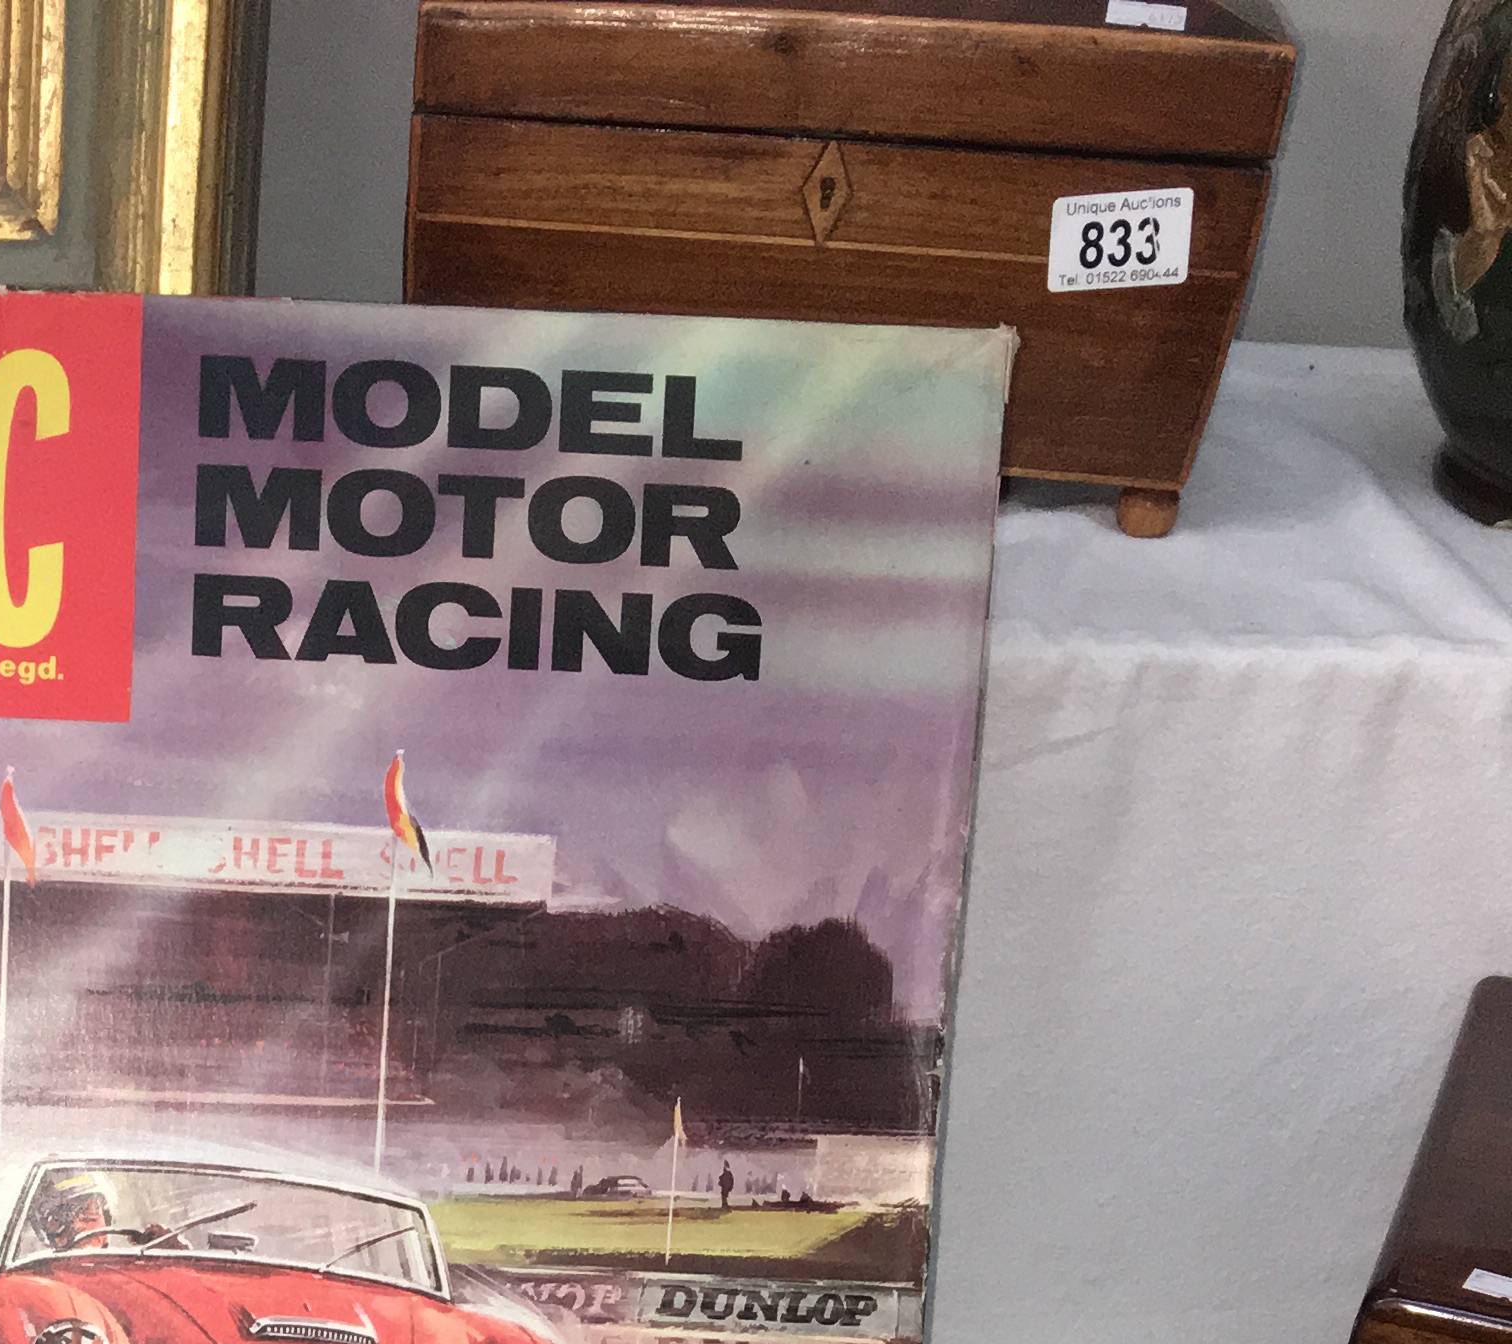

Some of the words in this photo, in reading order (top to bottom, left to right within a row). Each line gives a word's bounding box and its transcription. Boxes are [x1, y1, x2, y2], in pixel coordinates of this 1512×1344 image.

[1066, 200, 1117, 217] Unique
[1078, 216, 1162, 270] 833
[1085, 271, 1127, 285] 01522
[196, 352, 744, 462] MODEL
[192, 463, 743, 572] MOTOR
[189, 573, 764, 683] RACING
[655, 1284, 878, 1327] DUNLOP
